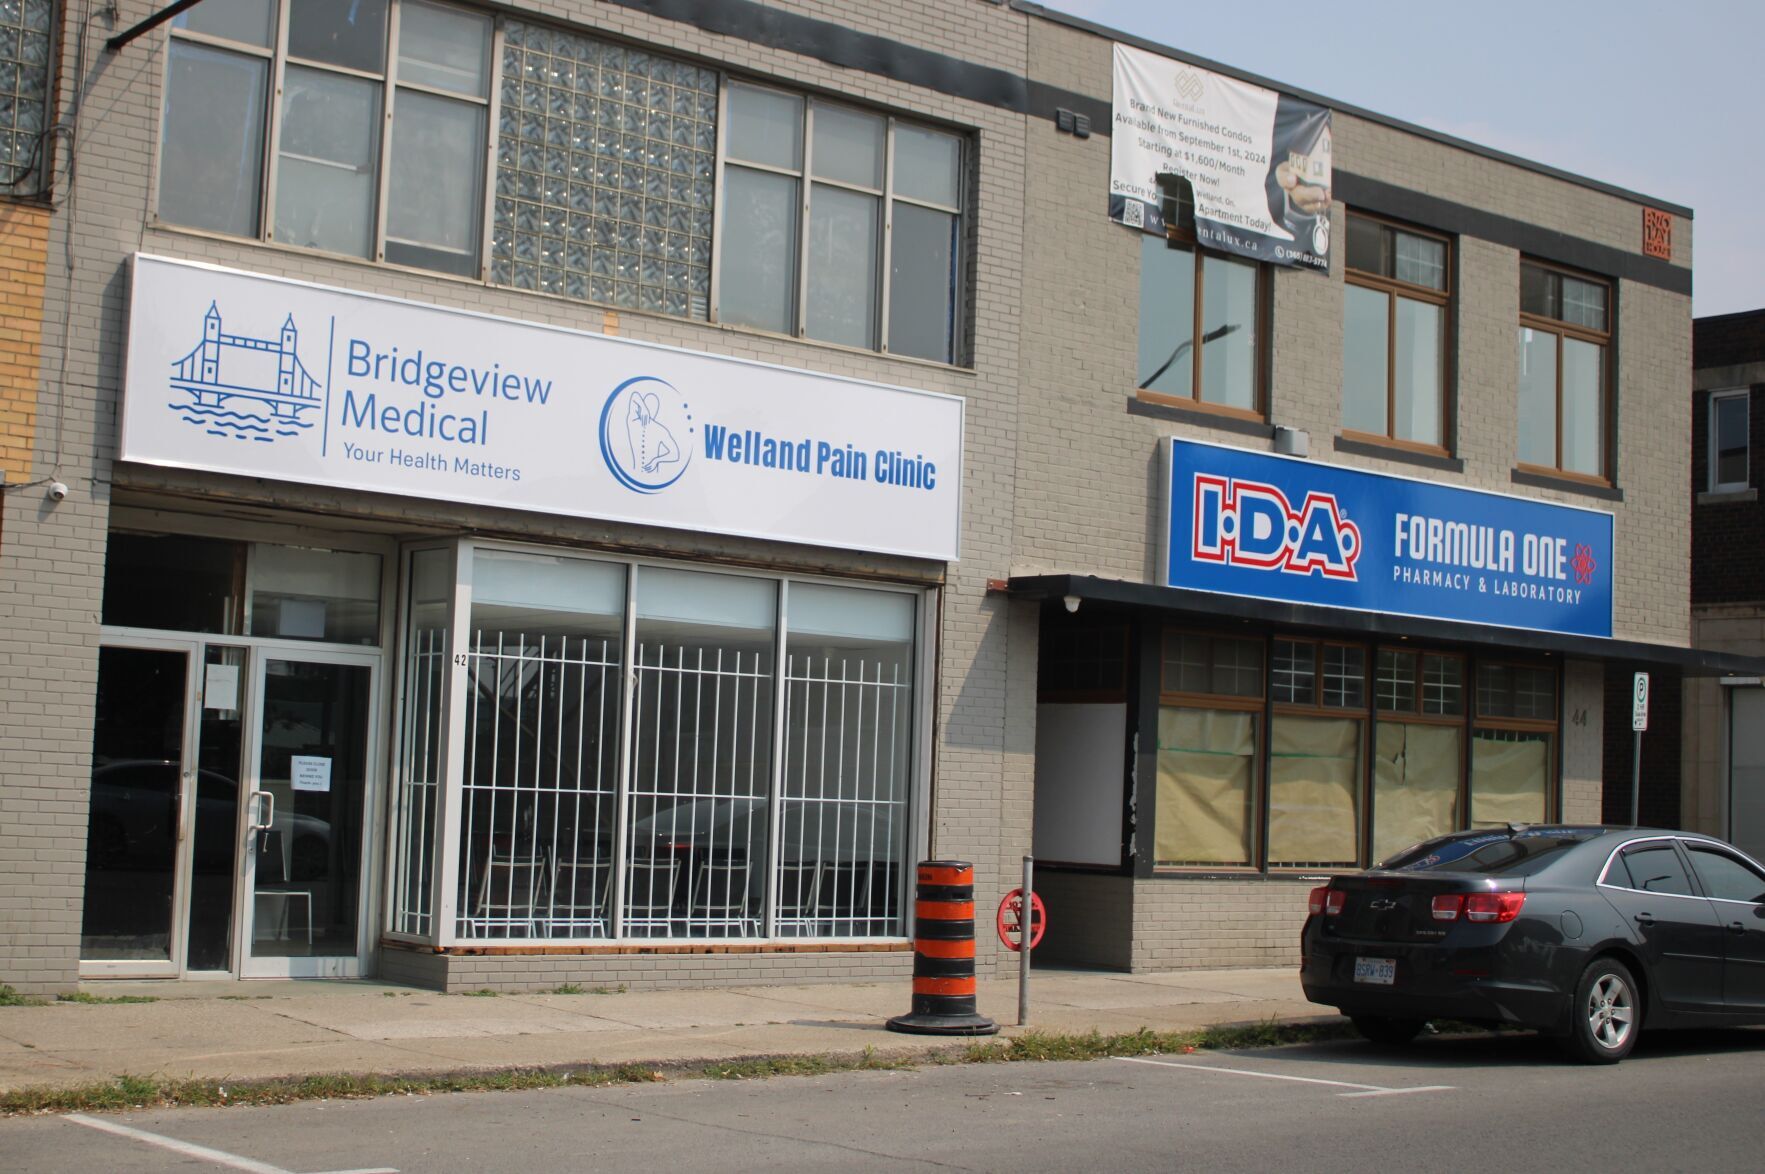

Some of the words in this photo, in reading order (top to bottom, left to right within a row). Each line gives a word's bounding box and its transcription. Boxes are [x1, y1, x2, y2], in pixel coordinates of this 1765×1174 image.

[1130, 98, 1156, 115] Brand
[1157, 108, 1177, 121] New
[1178, 113, 1220, 134] Furnished
[1222, 126, 1252, 144] Condos
[1138, 137, 1173, 158] Starting
[1174, 149, 1183, 158] at
[1158, 124, 1177, 139] from
[1178, 132, 1224, 153] September
[1244, 150, 1266, 165] 2024
[1162, 162, 1198, 179] Register
[1199, 173, 1220, 187] Now!
[1113, 179, 1146, 197] Secure
[1199, 203, 1243, 223] Apartment
[1245, 215, 1272, 233] Today!
[347, 338, 553, 404] Bridgeview
[341, 390, 488, 445] Medical
[343, 441, 384, 464] Your
[389, 447, 448, 472] Health
[454, 456, 521, 481] Matters
[704, 423, 811, 473] Welland
[816, 440, 867, 481] Pain
[874, 449, 936, 491] Clinic
[1394, 512, 1515, 574] FORMULA
[1522, 533, 1567, 581] ONE
[1393, 565, 1470, 591] PHARMACY
[1478, 576, 1487, 593] &
[1494, 579, 1581, 605] LABORATORY
[454, 654, 467, 667] 42
[1572, 708, 1588, 728] 44
